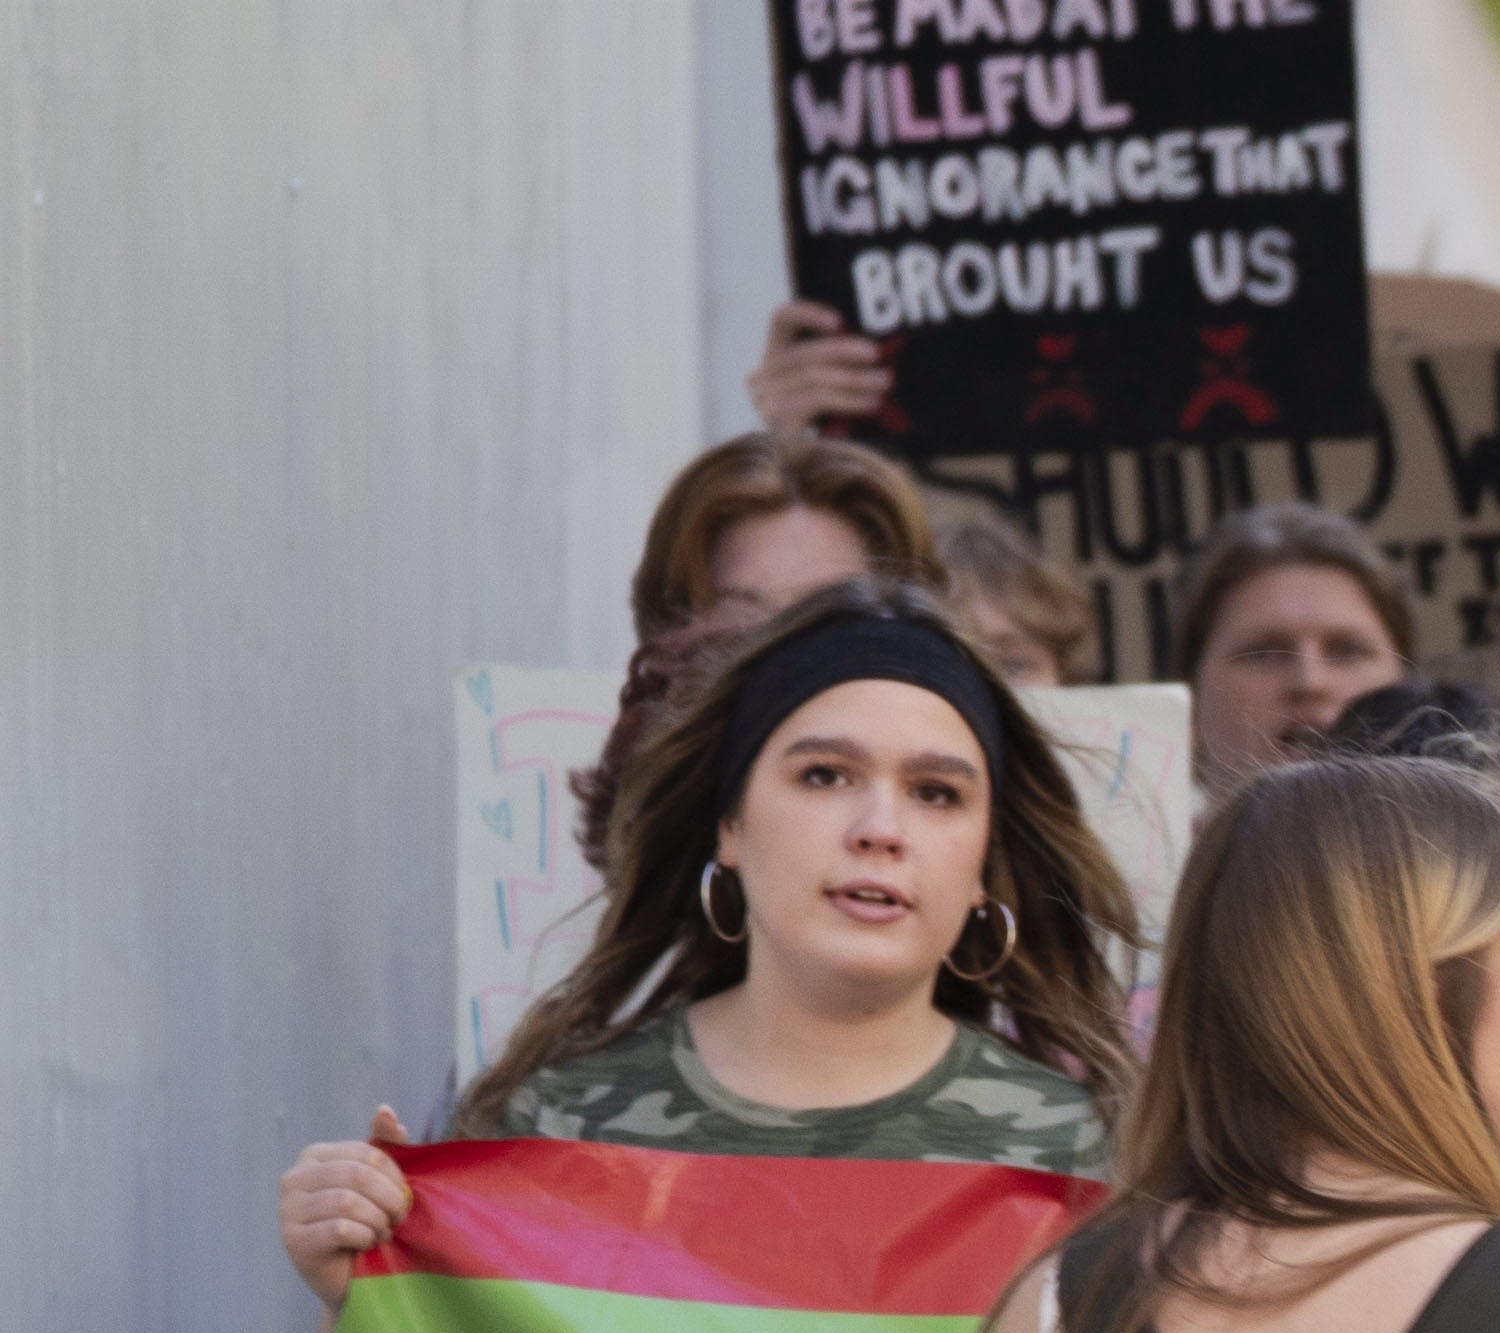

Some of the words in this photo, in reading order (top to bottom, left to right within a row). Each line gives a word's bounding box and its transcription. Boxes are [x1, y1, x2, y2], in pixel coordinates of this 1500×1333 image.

[792, 47, 1132, 154] WILLFUL
[805, 137, 1200, 236] IGNORANCE
[1200, 122, 1350, 195] THAT
[852, 226, 1162, 332] BROUHT
[1191, 228, 1297, 305] US
